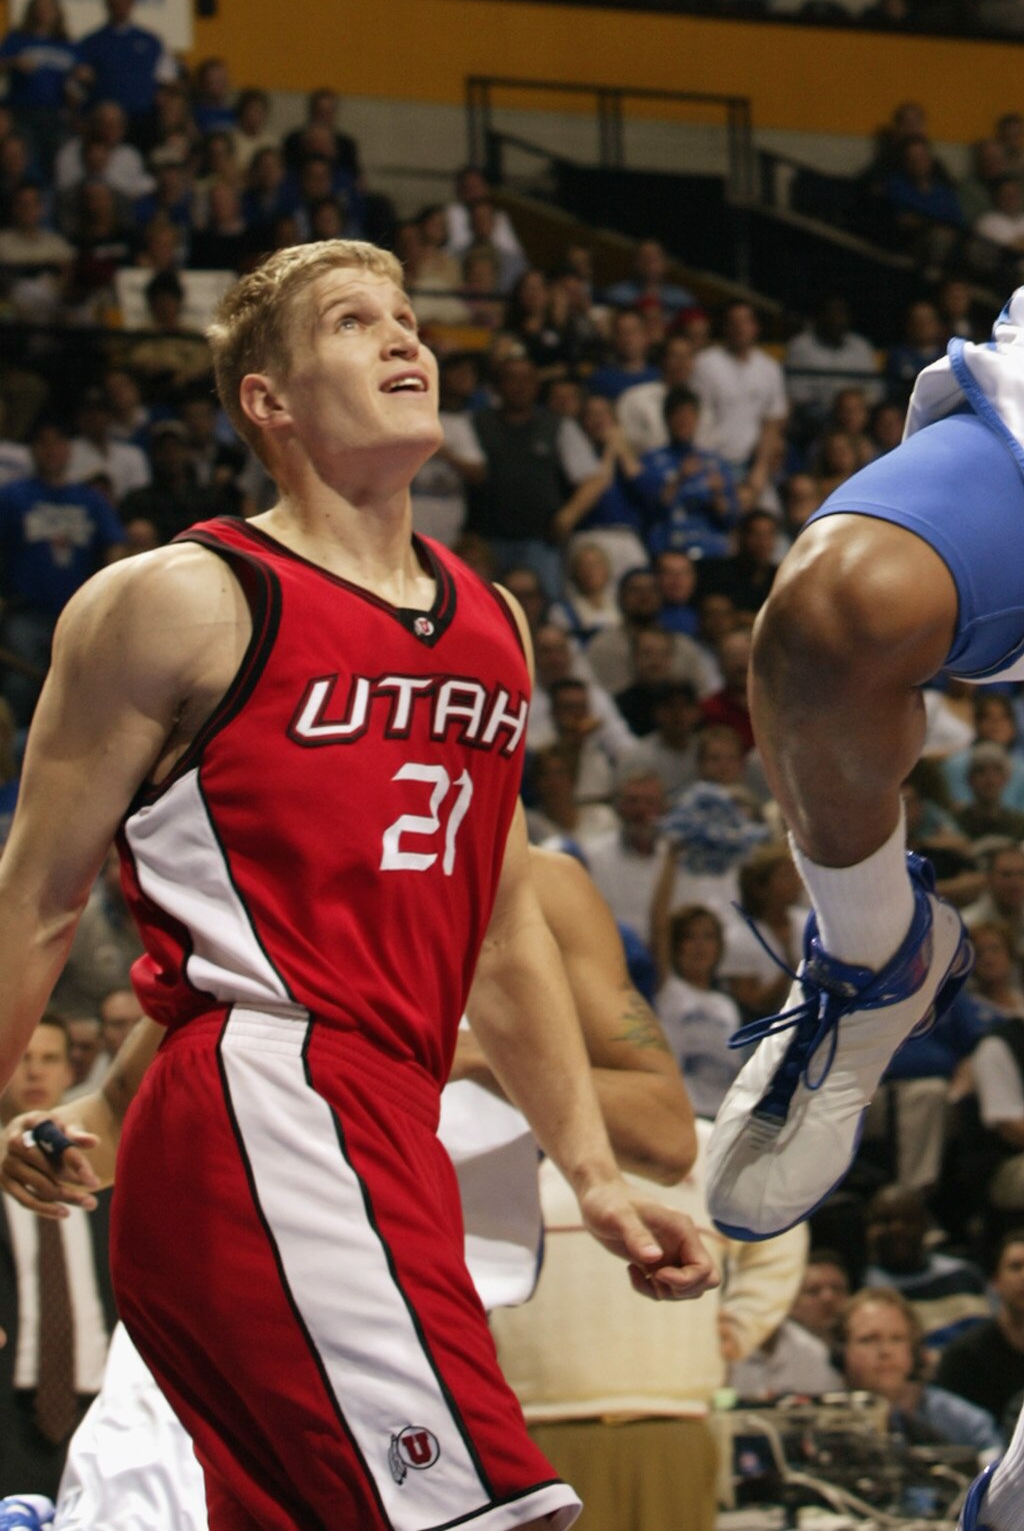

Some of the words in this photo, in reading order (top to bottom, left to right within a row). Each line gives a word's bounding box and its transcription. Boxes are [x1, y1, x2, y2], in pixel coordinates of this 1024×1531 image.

[288, 674, 528, 756] UTAH
[379, 762, 474, 876] 21
[401, 1431, 432, 1465] U
